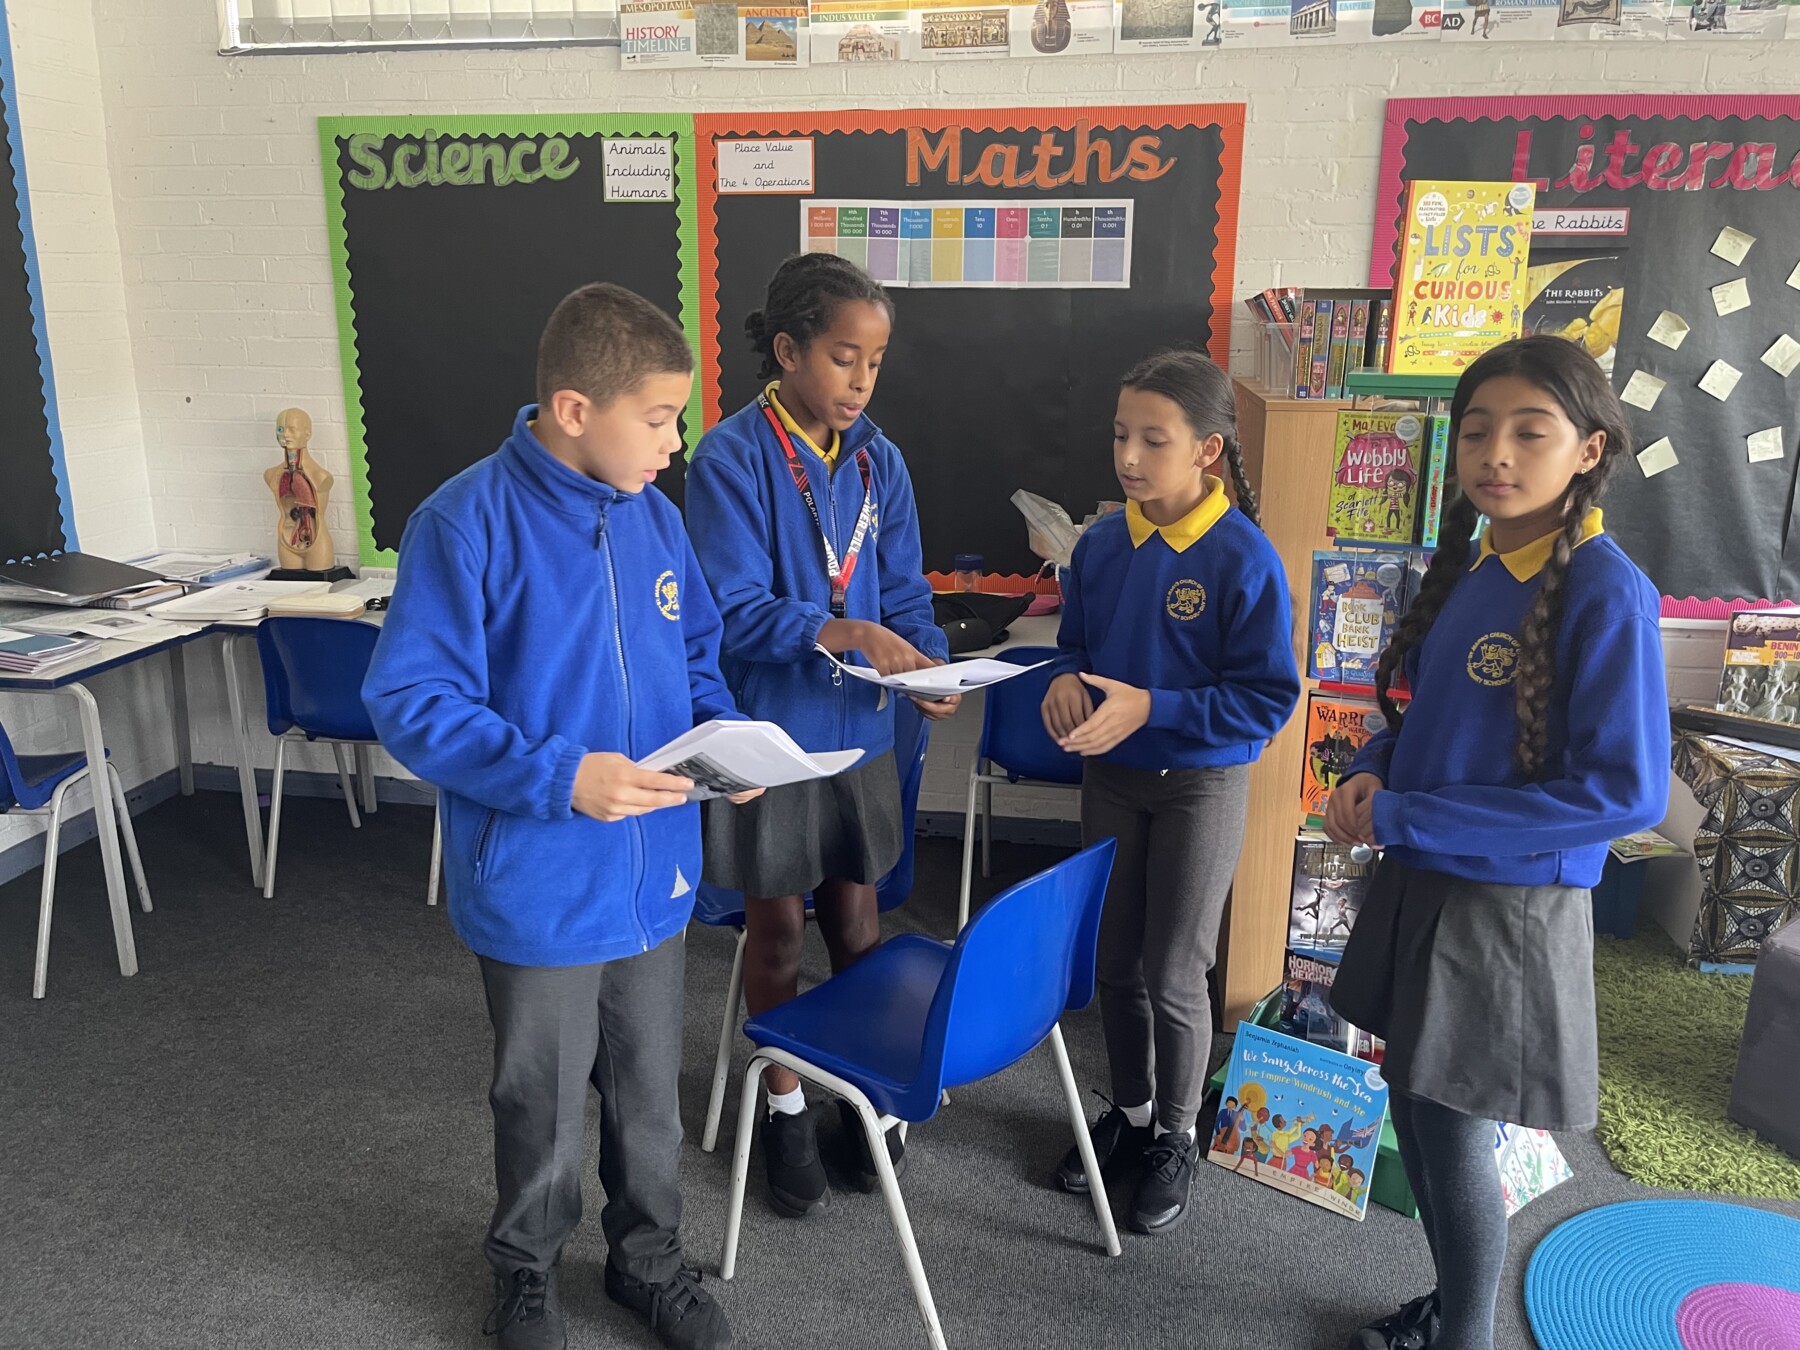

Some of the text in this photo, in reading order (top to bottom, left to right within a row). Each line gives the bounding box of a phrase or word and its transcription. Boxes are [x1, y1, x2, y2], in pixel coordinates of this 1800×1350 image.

[626, 0, 694, 13] MESOPOTAMIA
[745, 7, 788, 17] ANCIENT
[819, 13, 877, 22] INDUS VALLEY
[1424, 14, 1439, 24] BC
[1443, 17, 1461, 27] AD
[626, 26, 680, 40] HISTORY
[624, 38, 688, 53] TIMELINE
[609, 142, 667, 155] Animals
[734, 142, 794, 153] Place Value
[905, 119, 1177, 189] Maths
[348, 129, 581, 190] Science
[753, 160, 775, 170] and
[606, 164, 671, 181] Including
[719, 177, 811, 190] The 4 Operations
[611, 185, 668, 198] Humans
[1555, 214, 1624, 230] Rabbits
[1424, 224, 1517, 257] LISTS
[1455, 258, 1481, 281] for
[1413, 280, 1512, 300] CURIOUS
[1545, 288, 1563, 298] THE
[1433, 304, 1488, 328] Kids
[1377, 420, 1397, 432] Eva
[1347, 447, 1407, 467] Wobbly
[1347, 467, 1383, 484] Life
[1347, 492, 1357, 501] of
[803, 491, 820, 527] POLART
[1336, 496, 1378, 513] Scarlett
[847, 489, 871, 553] OWER FILL
[823, 532, 840, 577] POW
[1342, 601, 1366, 612] BOOK
[1345, 611, 1380, 625] CLUB
[1342, 623, 1369, 634] BANK
[1337, 633, 1378, 648] HEIST
[1770, 641, 1800, 651] BENIN
[1350, 669, 1375, 682] Quayl
[1316, 705, 1365, 728] WARRI
[1288, 954, 1333, 977] HORROR
[1290, 968, 1333, 987] HEIGHTS
[1245, 1030, 1300, 1054] Benjamin Zephaniah
[1243, 1049, 1259, 1062] We
[1262, 1052, 1298, 1075] Sang
[1294, 1060, 1329, 1080] Across
[1332, 1073, 1349, 1091] the
[1346, 1076, 1373, 1103] Sea
[1343, 1063, 1366, 1076] Onyiny
[1244, 1068, 1366, 1117] The Empire Windrush and Me
[1272, 1170, 1320, 1192] EMPIRE
